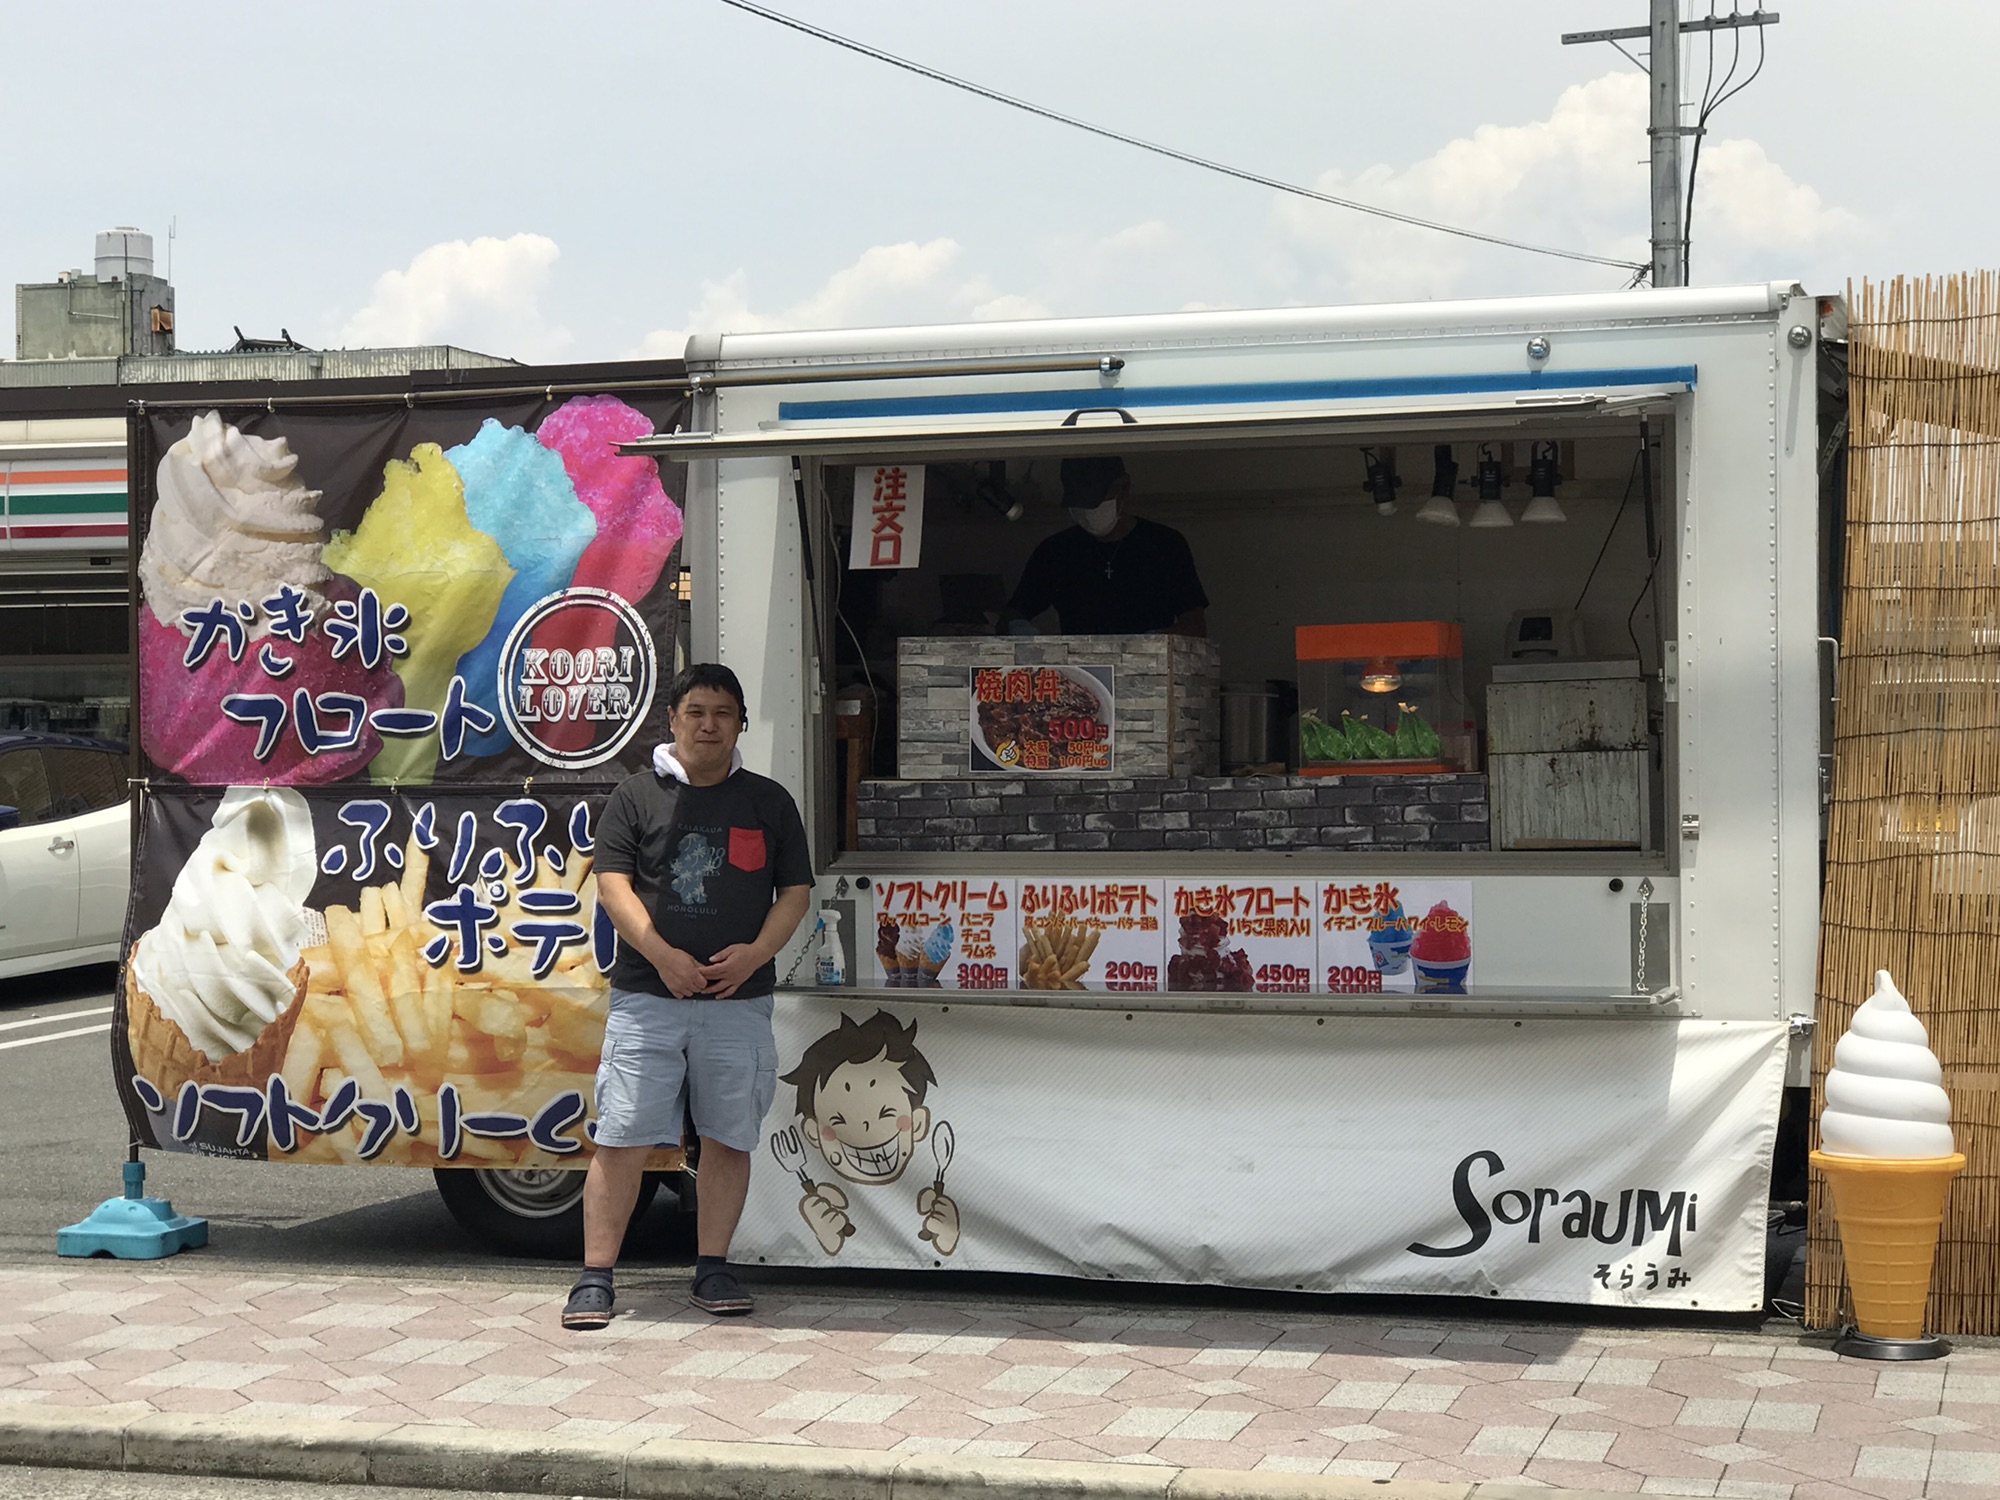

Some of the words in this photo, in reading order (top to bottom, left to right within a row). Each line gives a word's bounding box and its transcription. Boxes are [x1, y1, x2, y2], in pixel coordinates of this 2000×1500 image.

[869, 466, 908, 567] 注文口
[180, 583, 409, 676] かき氷
[520, 646, 636, 686] KOORI
[975, 669, 1061, 703] 焼肉丼
[517, 683, 634, 723] LOVER
[220, 674, 496, 761] フロート
[1047, 716, 1109, 740] 500円
[1023, 740, 1050, 755] 大盛
[1067, 740, 1110, 756] 50円up
[1059, 754, 1110, 769] 100円up
[875, 879, 1009, 912] ソフトクリーム
[1021, 883, 1159, 916] ふりふりポテト
[1174, 884, 1310, 917] かき氷フロート
[1322, 881, 1400, 917] かき氷
[667, 904, 717, 915] HONOLULU
[959, 912, 995, 926] バニラ
[876, 912, 953, 928] ワッフルコーン
[1228, 917, 1311, 937] いちご果肉入り
[960, 929, 991, 943] チョコ
[960, 944, 997, 960] ラムネ
[957, 963, 1009, 981] 300円
[1105, 961, 1158, 981] 200円
[1255, 964, 1310, 984] 450円
[1327, 965, 1383, 985] 200円
[199, 1142, 250, 1156] SUJAHTA
[1592, 1263, 1692, 1290] そらうみ
